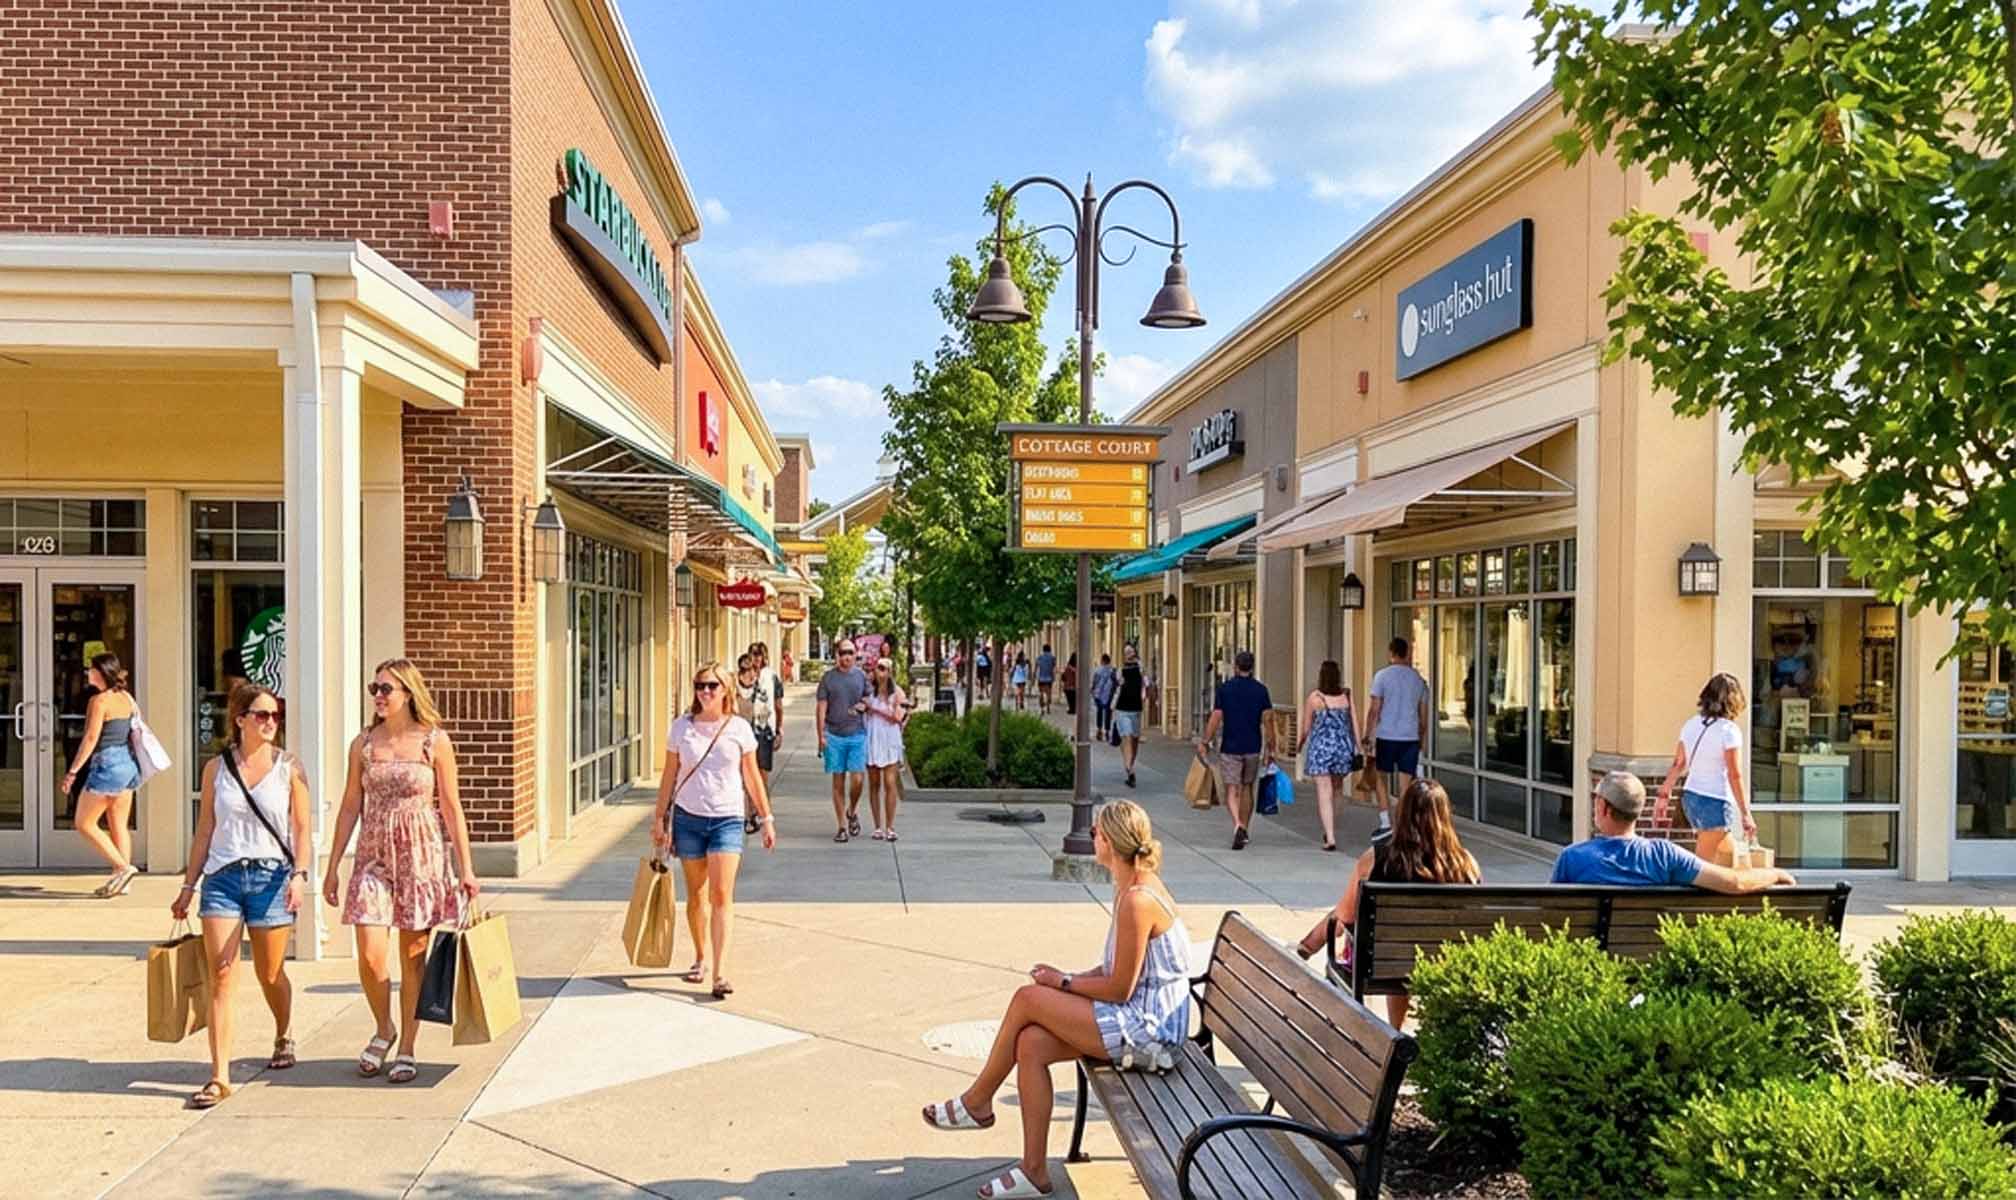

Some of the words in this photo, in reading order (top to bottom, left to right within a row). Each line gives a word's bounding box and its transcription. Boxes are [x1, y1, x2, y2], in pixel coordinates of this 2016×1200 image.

[1420, 280, 1482, 335] sunglass
[1485, 255, 1512, 304] hut
[1019, 438, 1092, 454] COTTAGE
[1097, 440, 1151, 455] COURT
